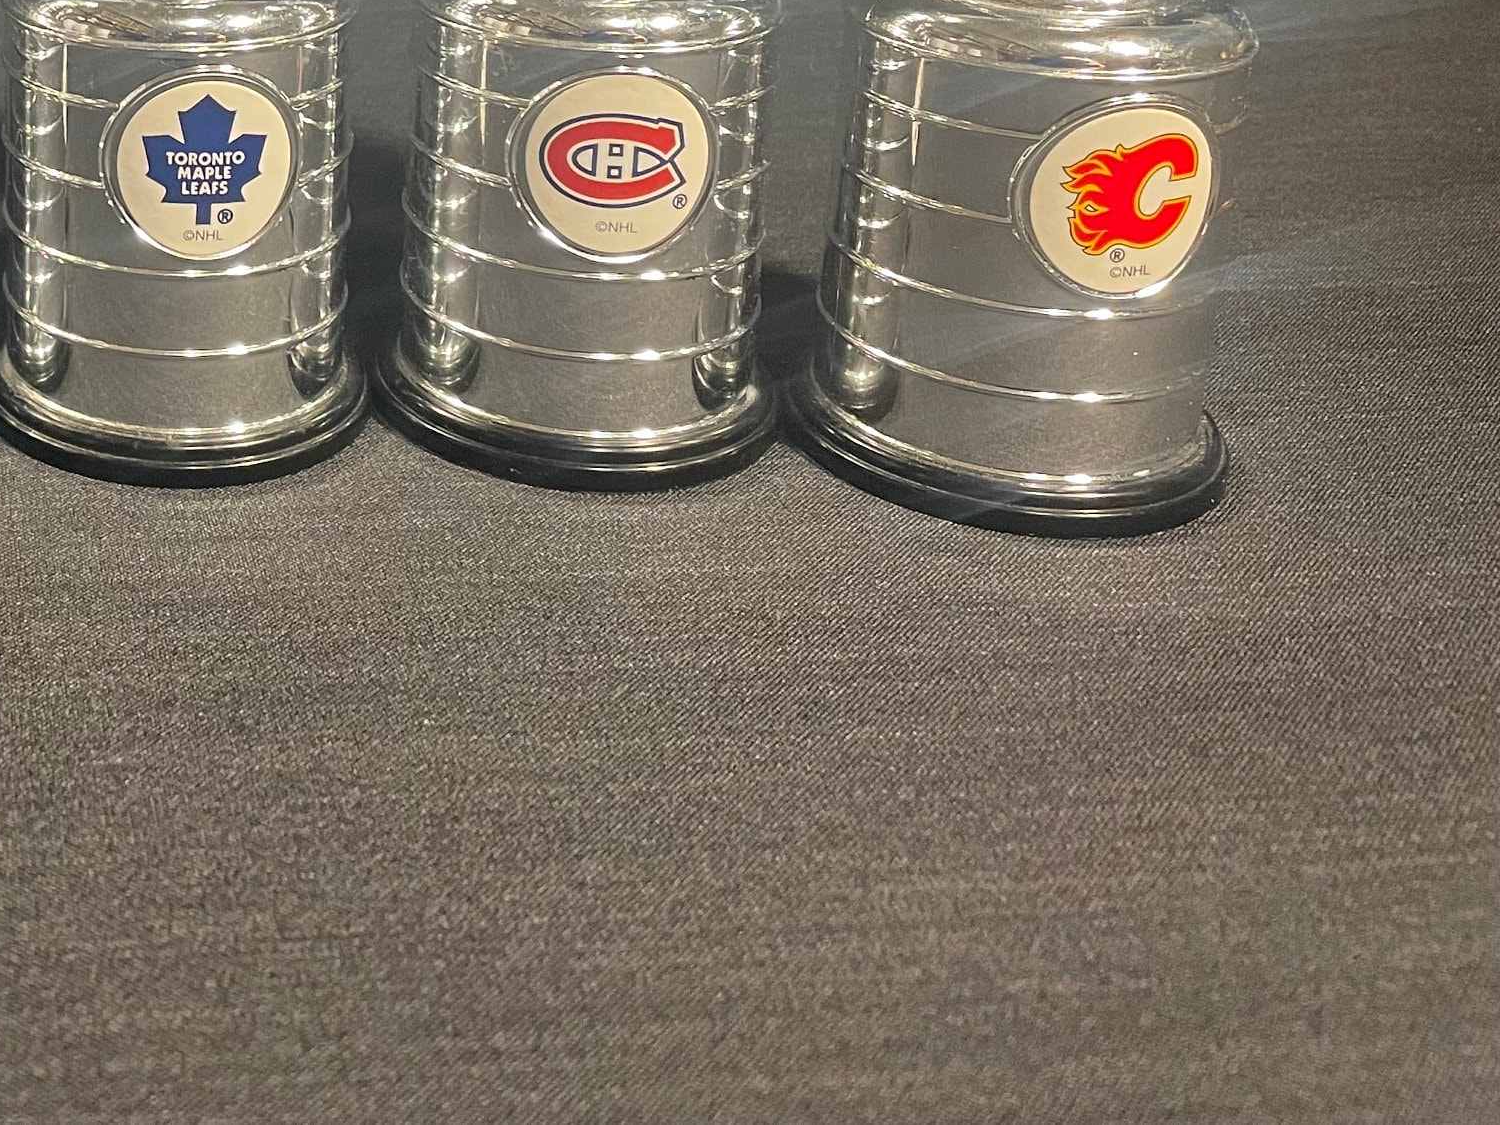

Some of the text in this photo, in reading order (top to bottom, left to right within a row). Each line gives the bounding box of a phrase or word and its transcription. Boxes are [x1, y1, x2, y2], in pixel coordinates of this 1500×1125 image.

[166, 151, 245, 166] TORONTO
[177, 166, 232, 180] MAPLE
[181, 181, 228, 195] LEAFS
